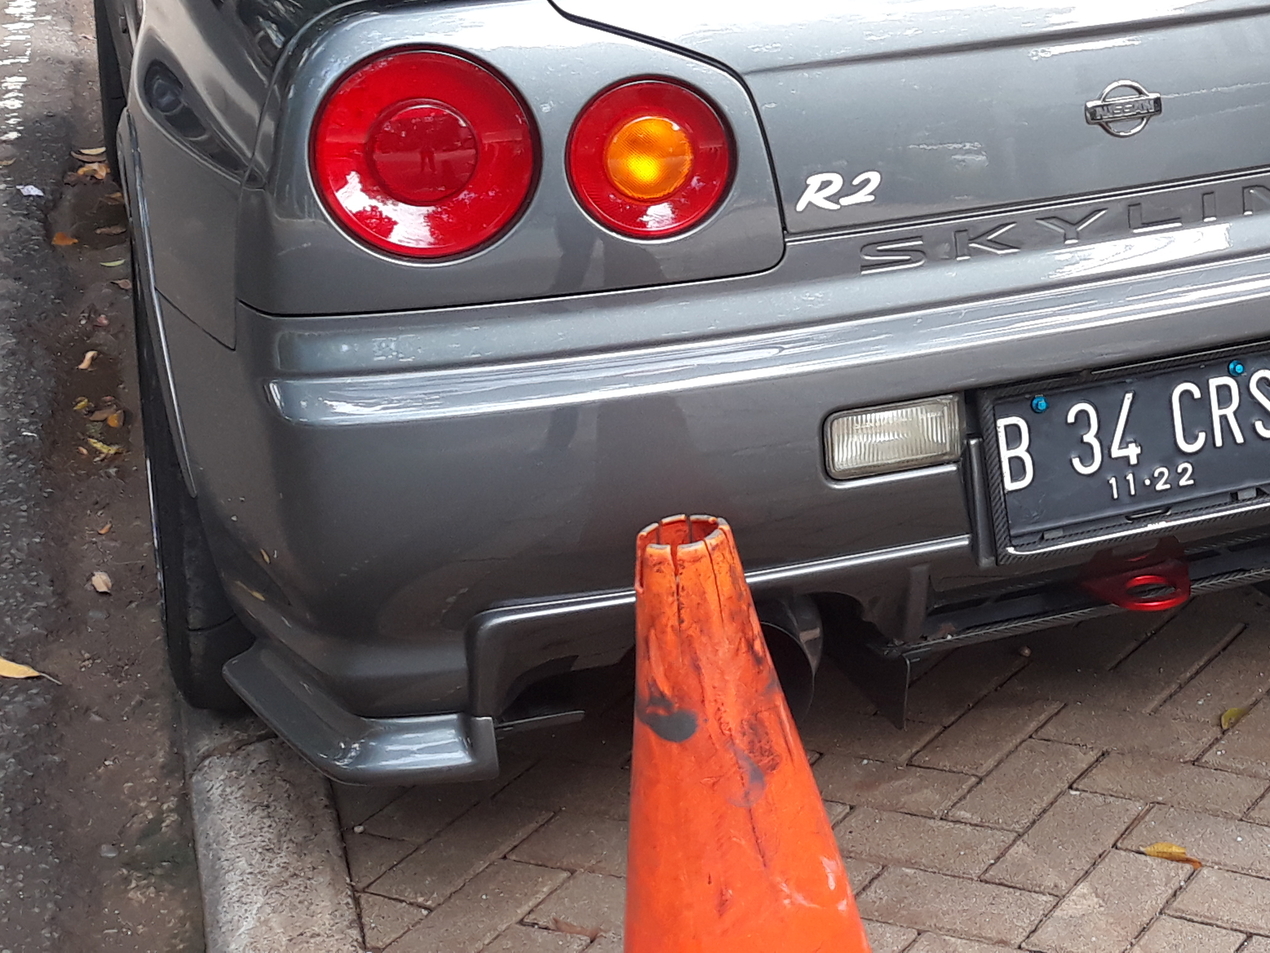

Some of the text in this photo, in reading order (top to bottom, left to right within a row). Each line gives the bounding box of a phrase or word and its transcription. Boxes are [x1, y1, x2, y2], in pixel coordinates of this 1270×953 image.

[1094, 99, 1155, 120] NISSAN
[796, 171, 882, 213] R2
[996, 416, 1035, 492] B
[1066, 392, 1142, 475] 34
